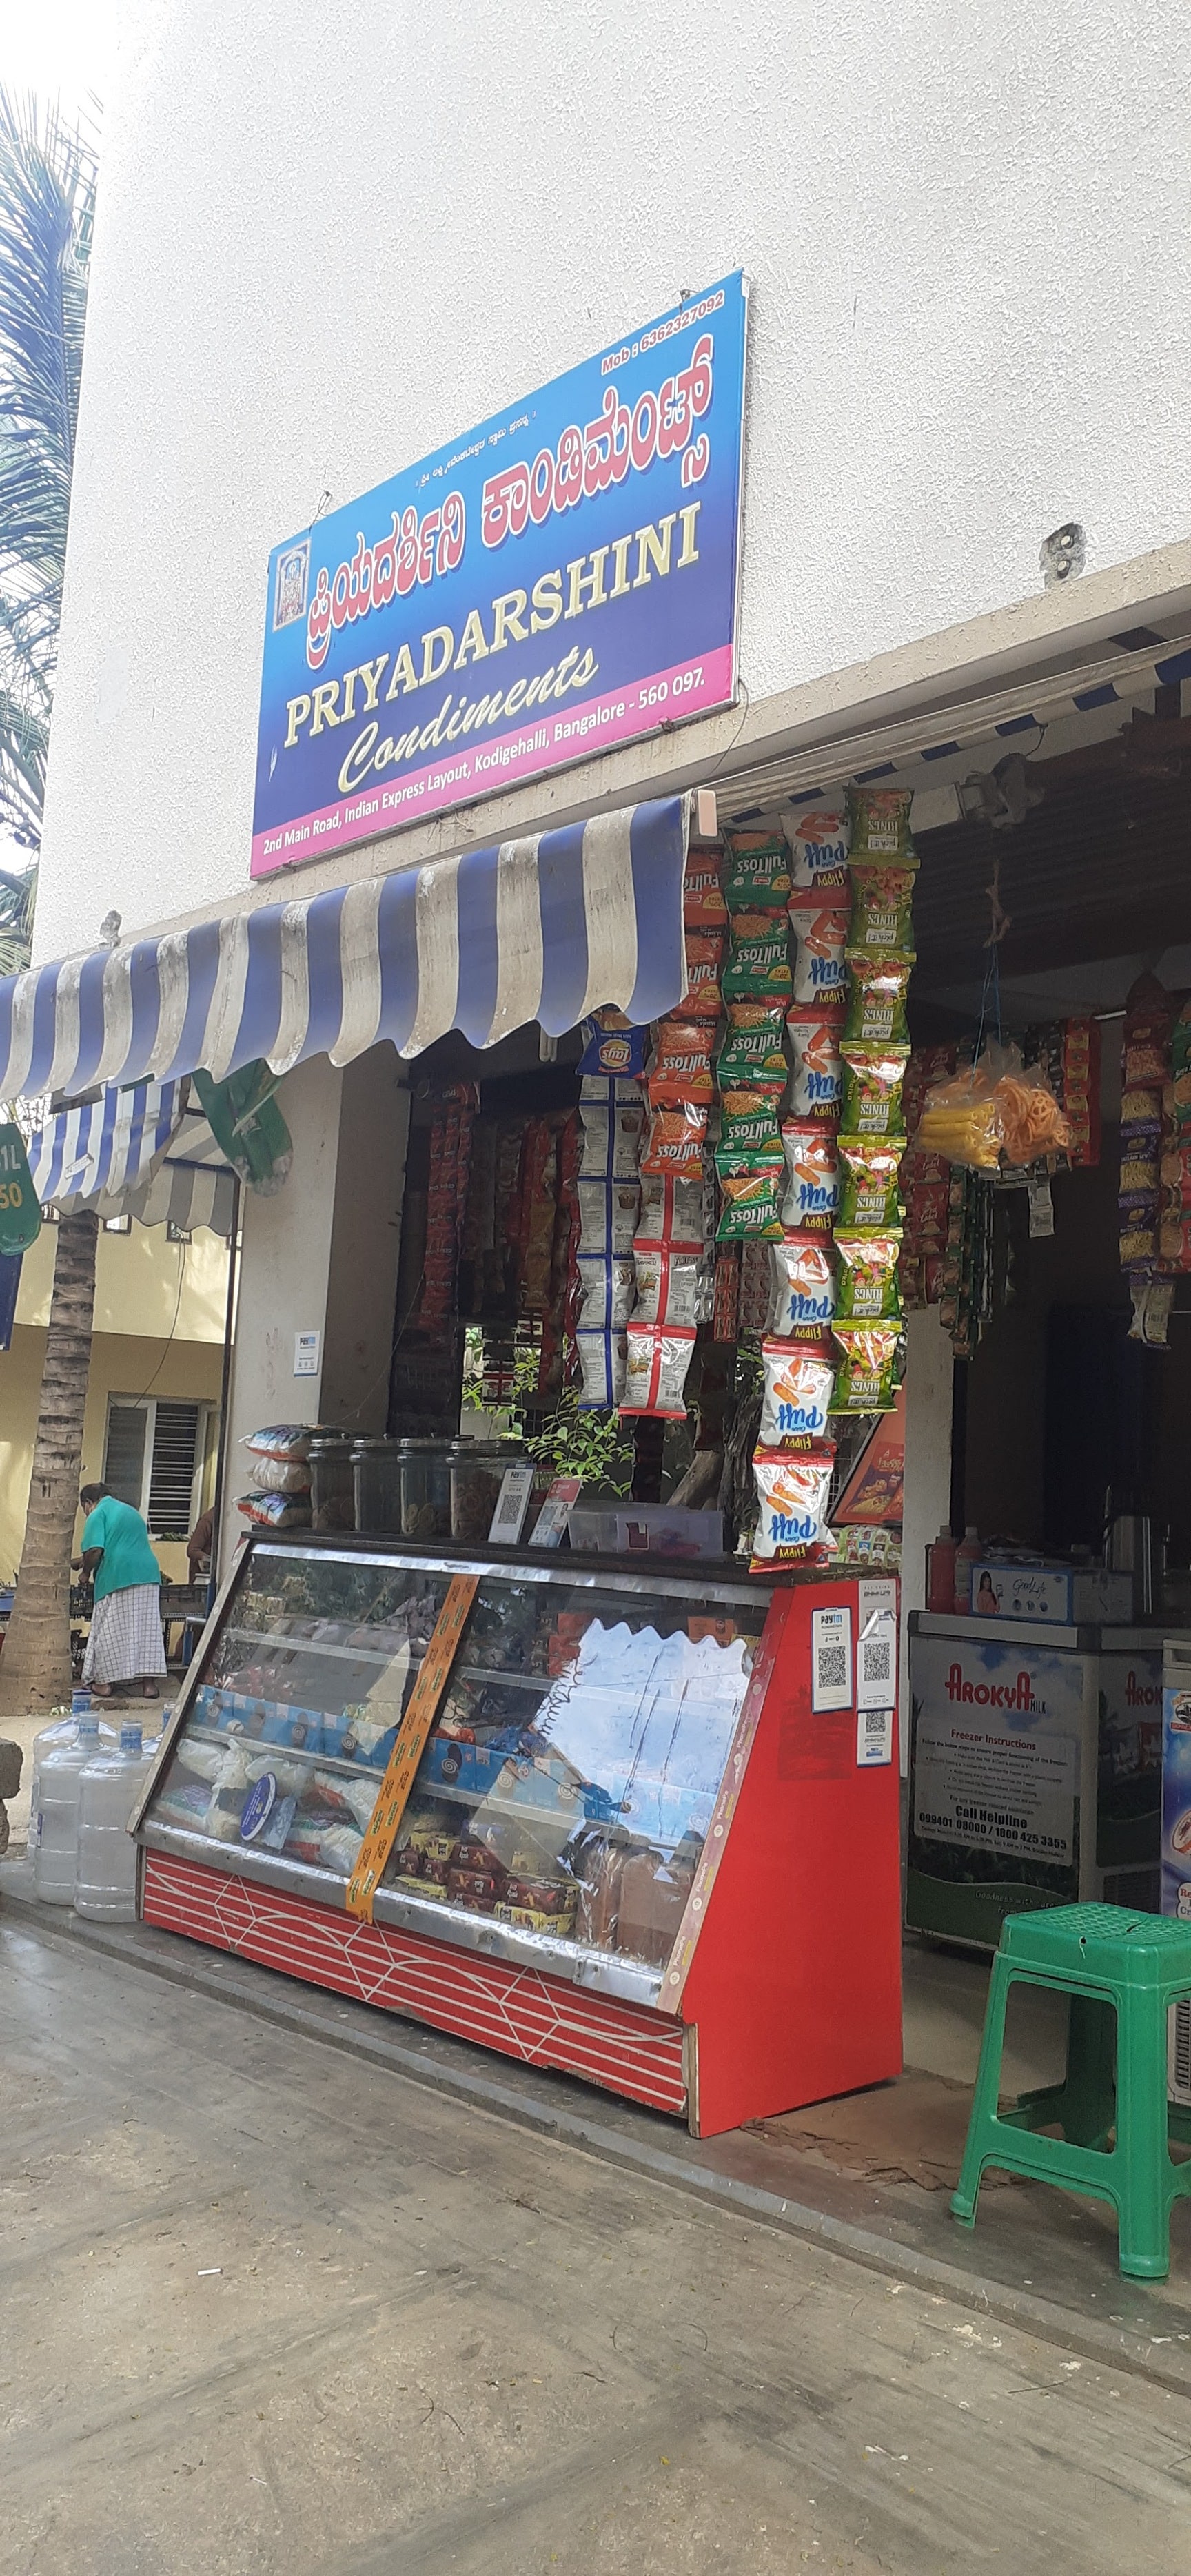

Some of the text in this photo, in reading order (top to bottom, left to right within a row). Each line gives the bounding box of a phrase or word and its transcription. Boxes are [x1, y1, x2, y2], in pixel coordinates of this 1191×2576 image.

[601, 348, 630, 375] Mob
[640, 291, 724, 352] 6362327092
[307, 491, 466, 669] ಪ್ರಿಯದರ್ಶಿನಿ
[284, 502, 701, 748] PRIYADARSHINI
[338, 644, 598, 792] Condiments
[263, 832, 282, 855] 2nd
[285, 825, 310, 848] Main
[313, 810, 342, 834] Road,
[345, 799, 379, 822] Indian
[382, 782, 425, 810] Express
[427, 761, 471, 793] Layout,
[474, 728, 550, 774] Kodigehalli,
[554, 702, 625, 742] Bangalore
[638, 681, 668, 709] 560
[672, 666, 705, 695] 097.
[868, 820, 897, 832] RINGS
[804, 841, 848, 869] Puff
[817, 870, 844, 887] Flippy
[867, 913, 897, 926] RINGS
[736, 943, 787, 964] FullToss
[819, 984, 846, 1003] Flippy
[864, 1009, 894, 1021] RINGS
[731, 1033, 782, 1052] FullToss
[602, 1047, 629, 1063] Lay's
[814, 1103, 840, 1118] Flippy
[859, 1103, 890, 1116] RINGS
[729, 1118, 778, 1139] FullToss
[796, 1182, 839, 1212] Puff
[857, 1197, 886, 1207] RINGS
[805, 1214, 832, 1230] Flippy
[853, 1289, 884, 1300] RINGS
[786, 1294, 835, 1323] Puff
[795, 1326, 822, 1340] Flippy
[851, 1380, 880, 1393] RINGS
[774, 1402, 824, 1431] Puff
[784, 1435, 812, 1449] Flippy
[767, 1513, 817, 1543] Puff
[778, 1546, 806, 1559] Flippy
[1030, 1699, 1047, 1715] MILK
[951, 1728, 1037, 1751] Freezer Instructions
[955, 1804, 1028, 1830] Call Helpline
[919, 1812, 953, 1828] 099401
[1019, 1831, 1039, 1846] 425
[1040, 1835, 1068, 1851] 3355
